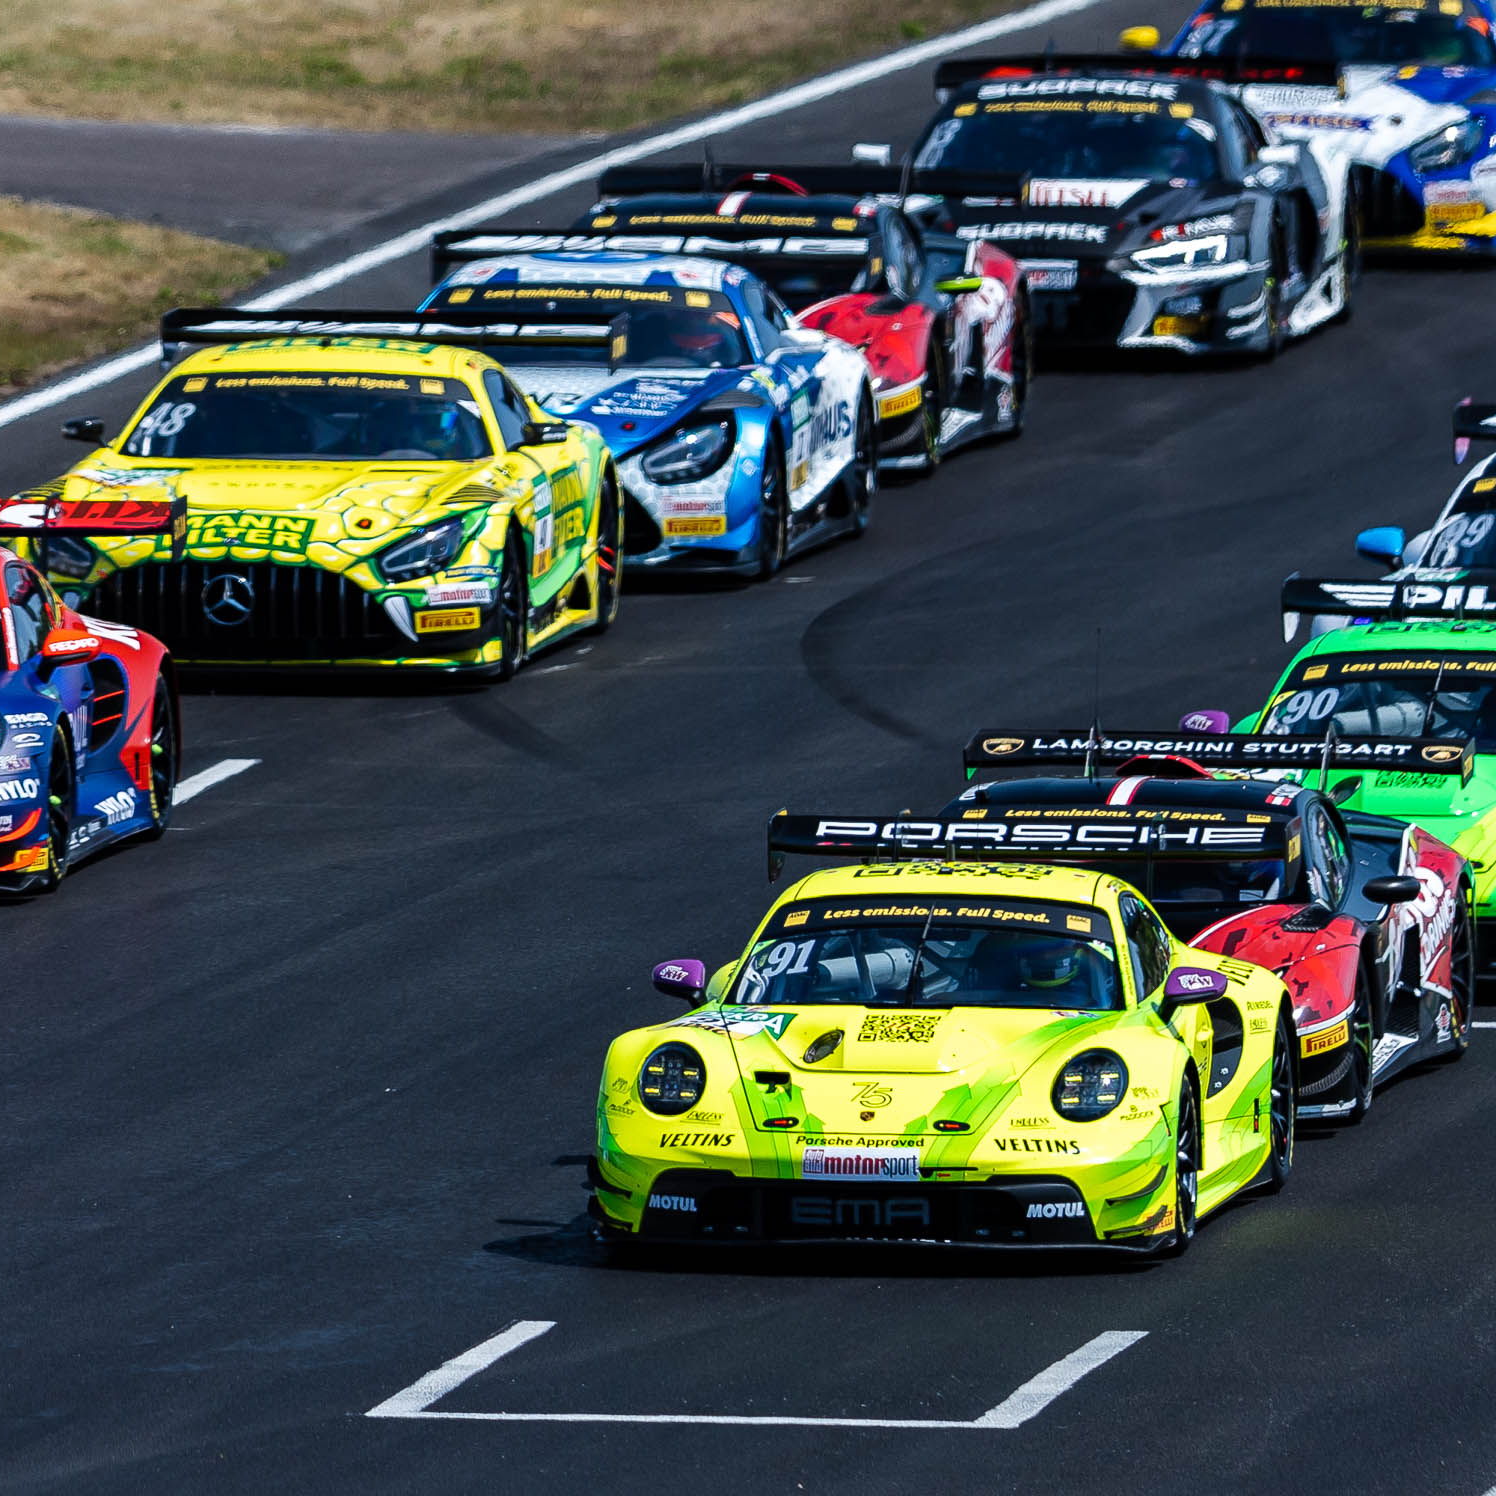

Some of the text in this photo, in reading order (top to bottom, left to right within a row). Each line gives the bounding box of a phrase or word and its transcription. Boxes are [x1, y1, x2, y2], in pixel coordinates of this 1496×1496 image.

[162, 527, 301, 550] ILTER
[419, 611, 476, 628] PIRELLI
[1341, 662, 1375, 674] Less
[1281, 687, 1340, 724] 90
[1032, 737, 1413, 757] LAMBORGHINI STUTTGART
[1005, 808, 1045, 818] Less
[1048, 808, 1132, 819] emissions.
[1173, 811, 1227, 822] Speed.
[815, 821, 1266, 844] PORSCHE
[823, 906, 1051, 925] Less emissions. Full Speed.
[765, 939, 816, 977] 91
[1305, 1021, 1346, 1053] PIRELLI
[850, 1081, 894, 1109] 75
[658, 1133, 736, 1148] VELTINS
[795, 1135, 925, 1149] Porsche Approved
[993, 1138, 1082, 1155] VELTINS
[823, 1154, 919, 1179] motorsport
[648, 1193, 698, 1213] MOTUL
[790, 1196, 931, 1226] EMA
[1026, 1201, 1086, 1219] MOTUL
